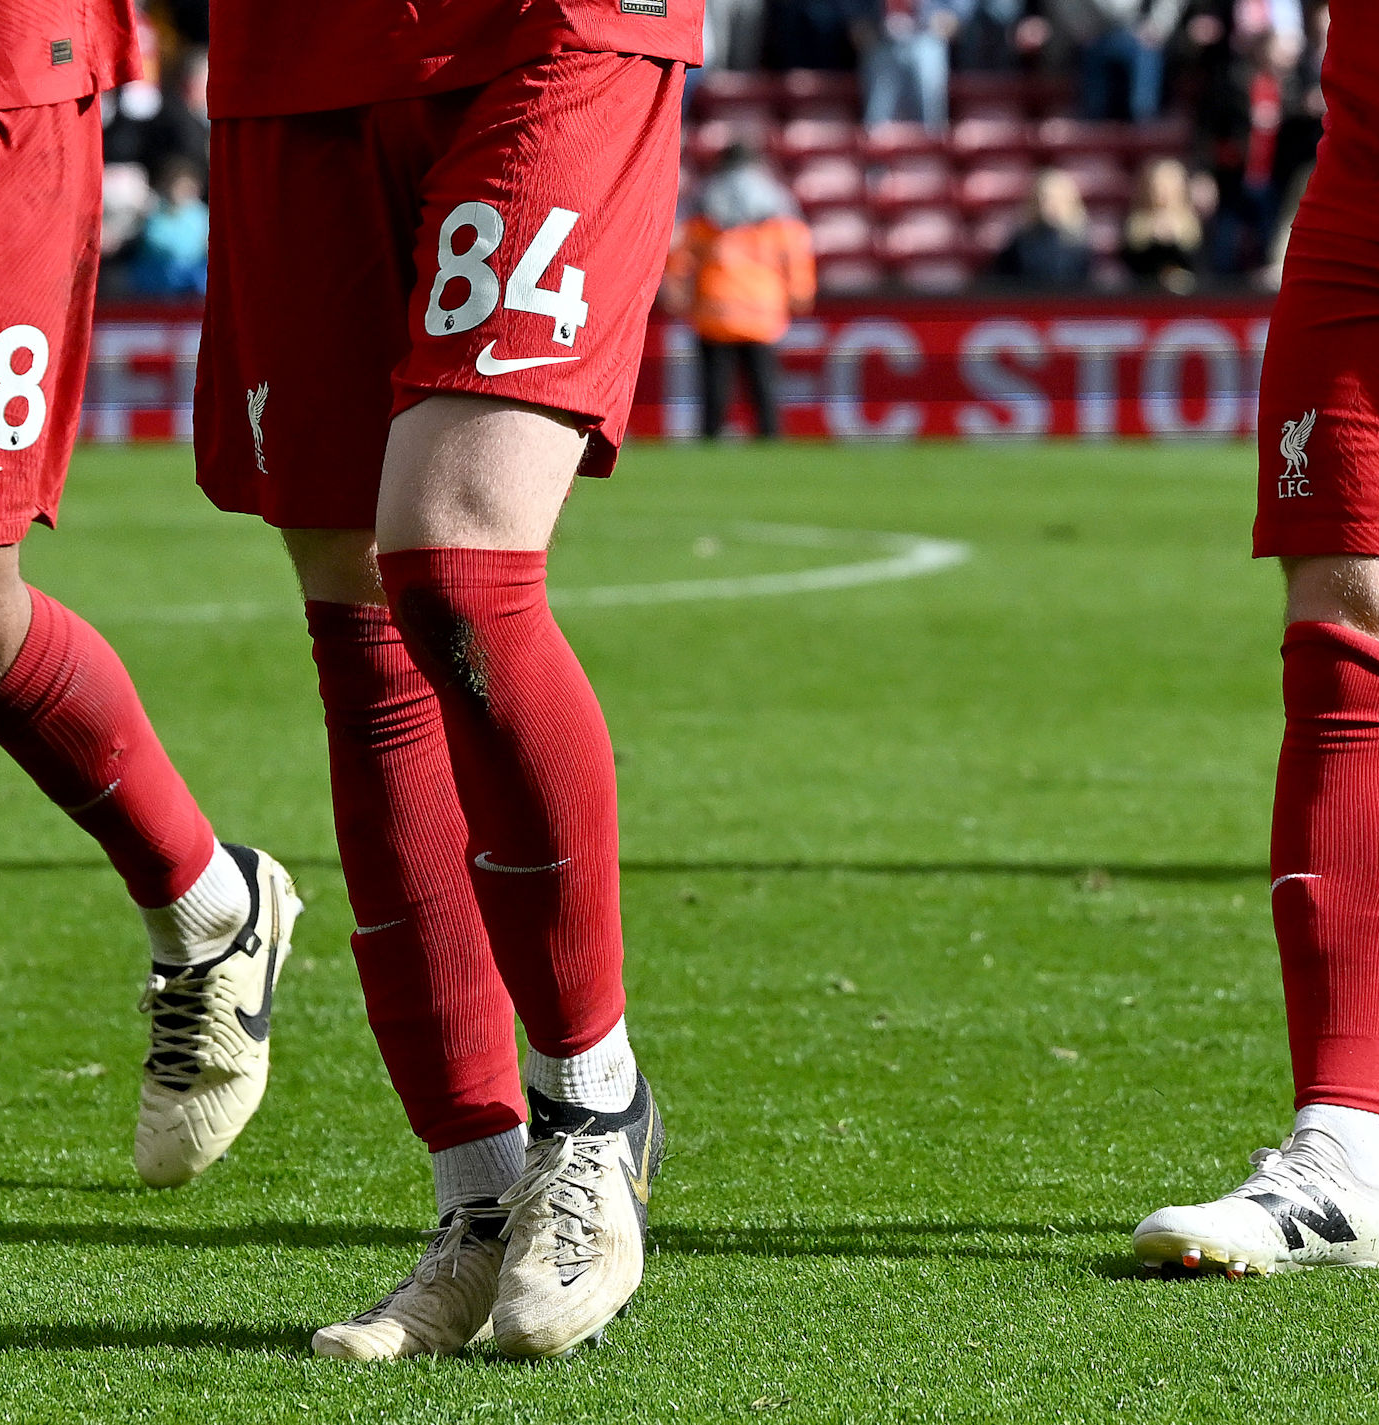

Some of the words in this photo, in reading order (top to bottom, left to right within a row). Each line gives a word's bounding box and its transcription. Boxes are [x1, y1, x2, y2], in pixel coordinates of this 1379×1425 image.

[424, 201, 589, 348] 84
[955, 317, 1270, 442] STO
[1277, 479, 1314, 499] L.F.C.
